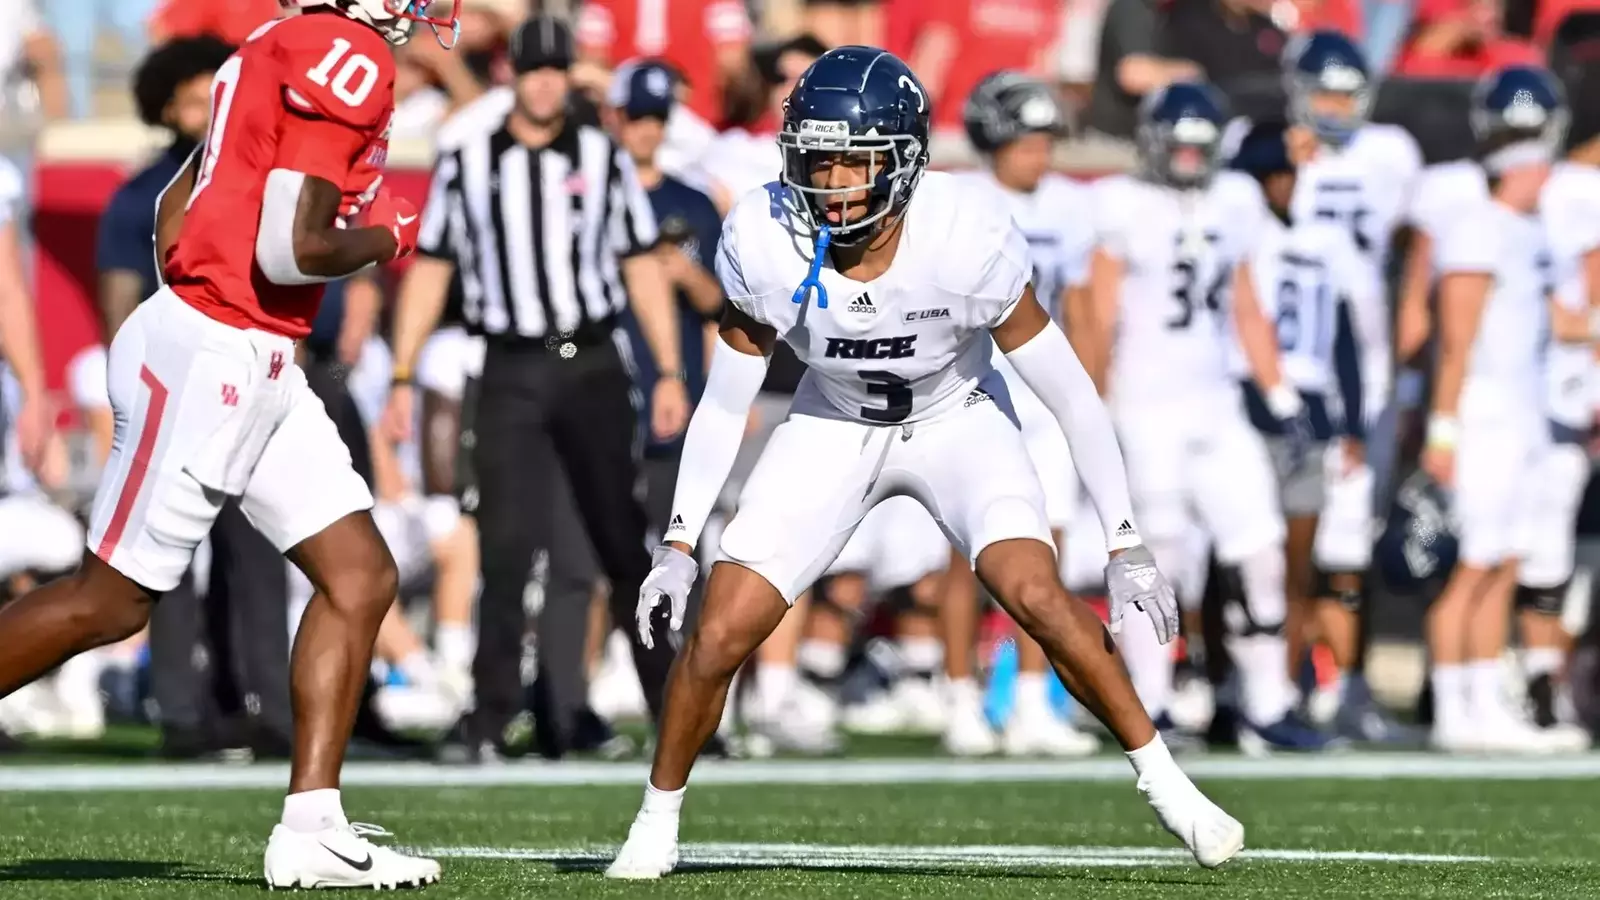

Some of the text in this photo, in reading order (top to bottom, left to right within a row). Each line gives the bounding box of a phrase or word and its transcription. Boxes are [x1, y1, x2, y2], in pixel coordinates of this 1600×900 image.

[306, 37, 379, 107] 10
[814, 124, 836, 133] RICE
[848, 304, 877, 314] adidas
[920, 308, 950, 319] USA
[824, 334, 918, 360] RICE
[857, 370, 913, 423] 3
